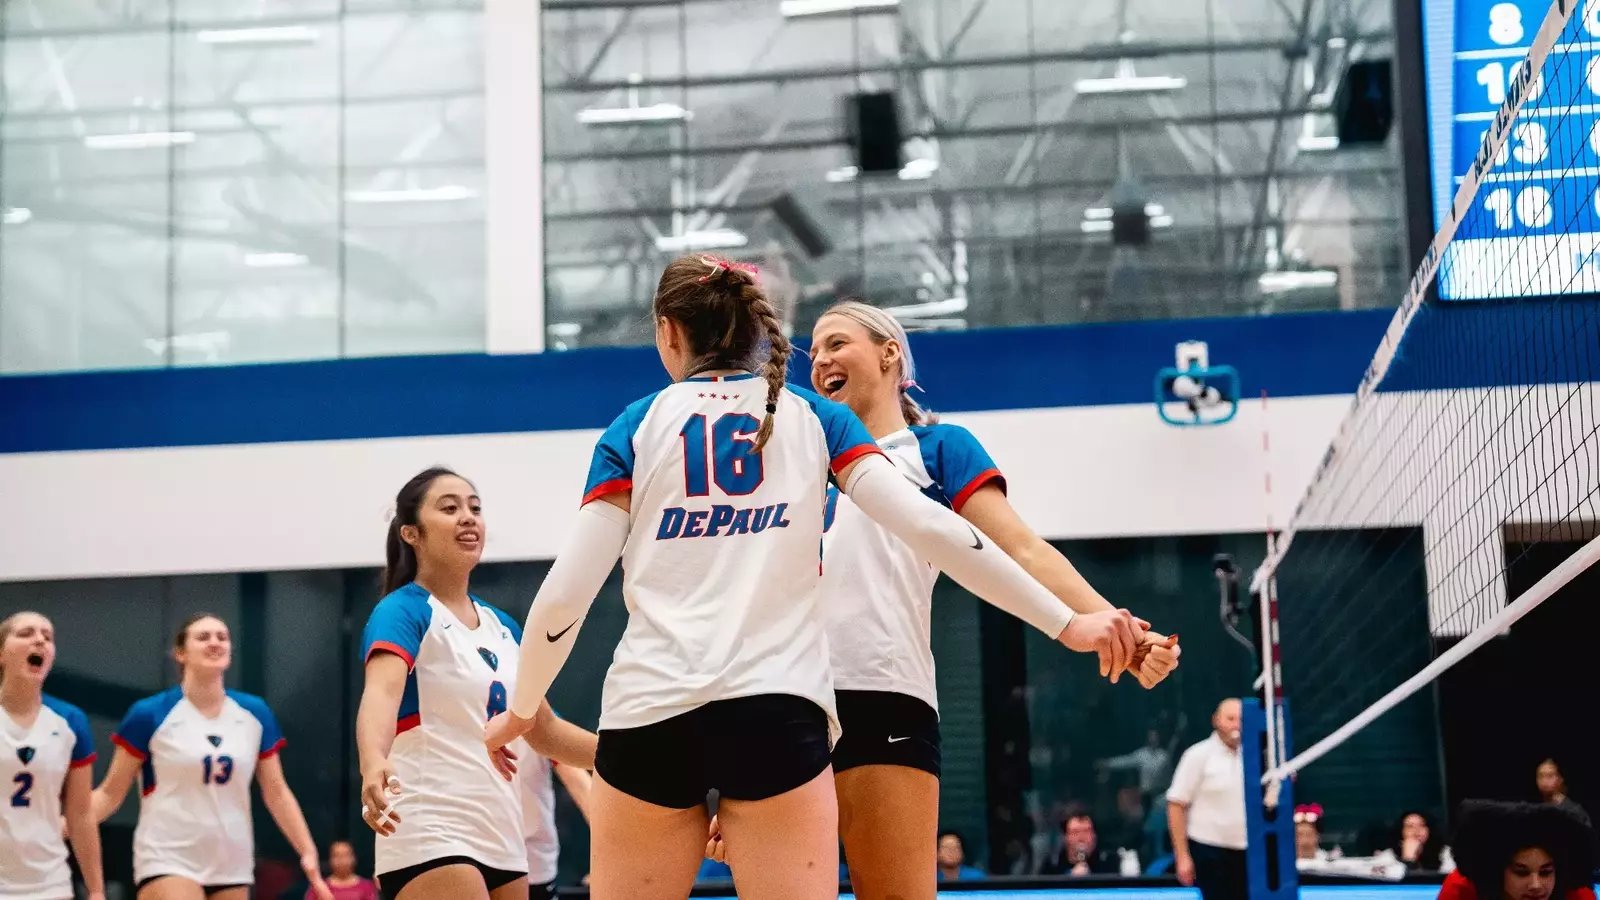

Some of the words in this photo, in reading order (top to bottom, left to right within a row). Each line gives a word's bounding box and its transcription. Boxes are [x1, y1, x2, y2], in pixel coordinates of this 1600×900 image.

[1489, 3, 1524, 45] 8
[679, 412, 764, 497] 16
[202, 755, 234, 785] 13
[10, 772, 34, 807] 2
